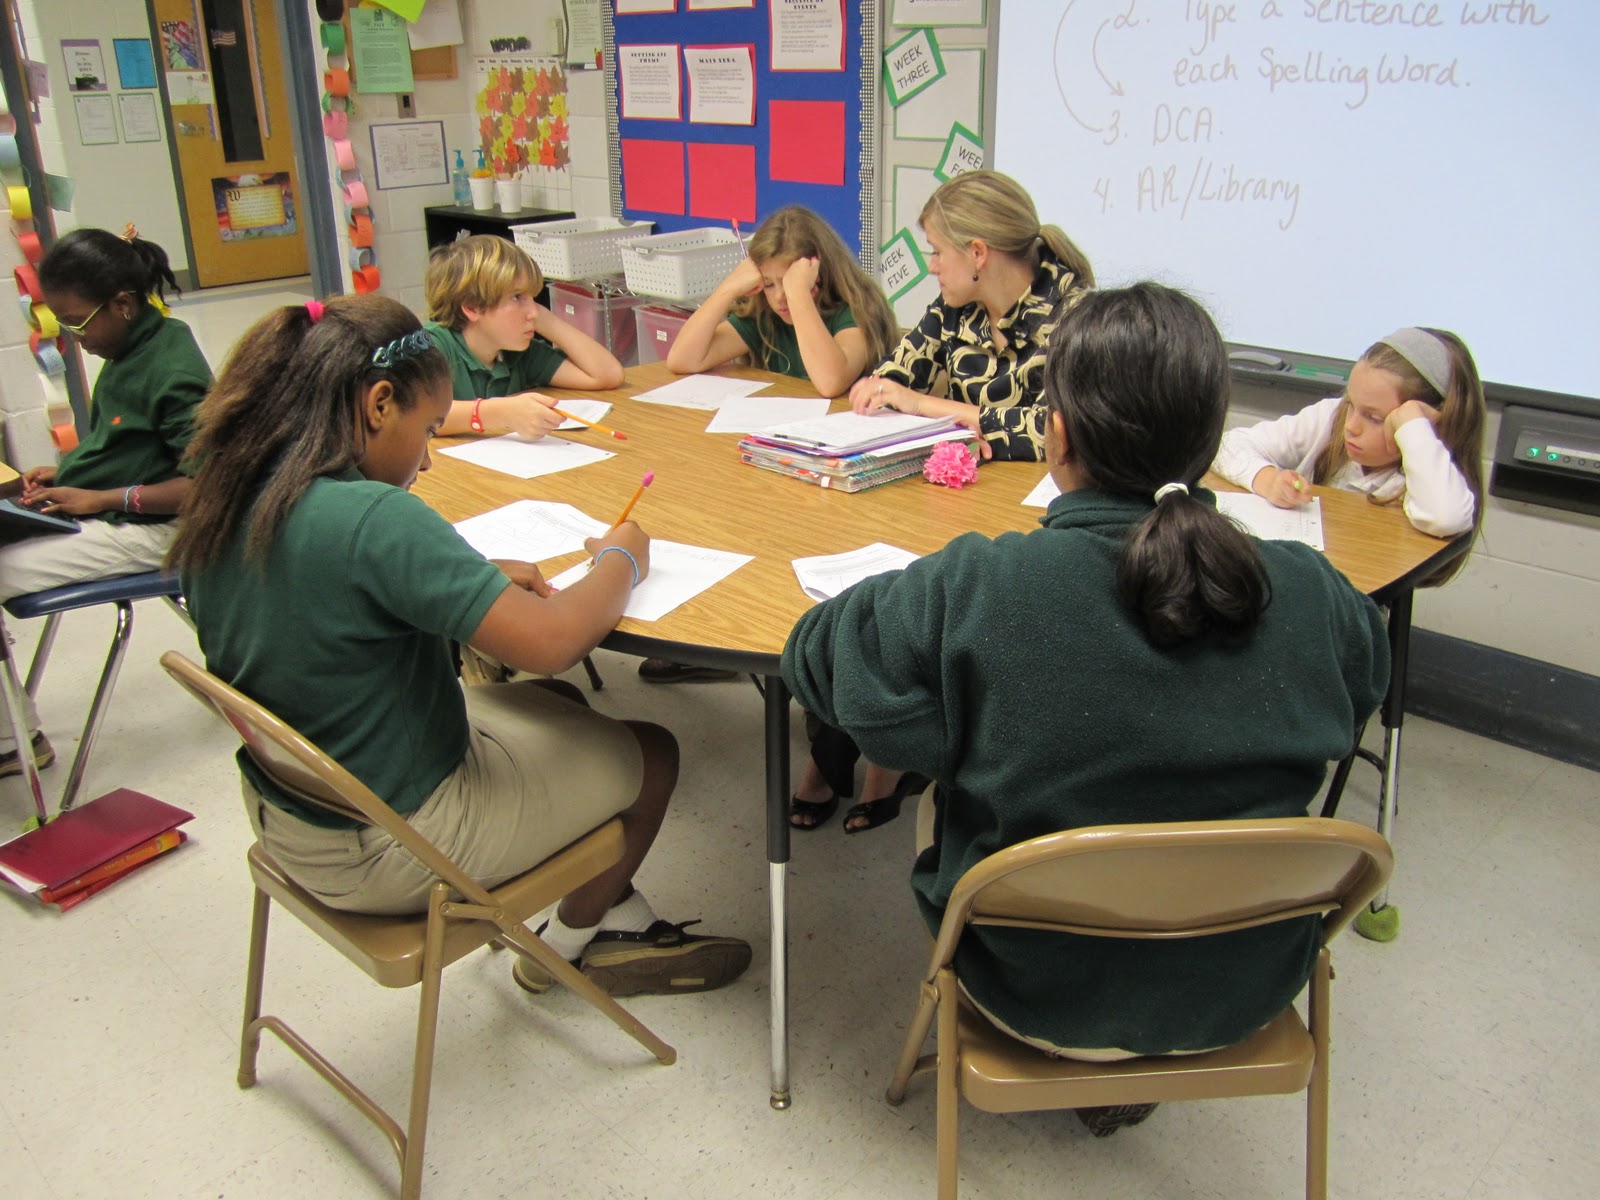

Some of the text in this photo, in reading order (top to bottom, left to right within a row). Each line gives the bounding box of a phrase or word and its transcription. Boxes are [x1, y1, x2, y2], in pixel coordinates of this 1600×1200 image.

[1260, 0, 1284, 19] a
[1459, 0, 1550, 26] with
[893, 45, 923, 71] WEEK
[896, 60, 931, 89] THREE
[1173, 53, 1239, 87] each
[1257, 46, 1369, 111] Spelling
[1102, 108, 1129, 146] 3.
[1092, 156, 1301, 232] 4. AR/Library
[879, 247, 905, 274] WEEK
[887, 263, 910, 289] FIVE
